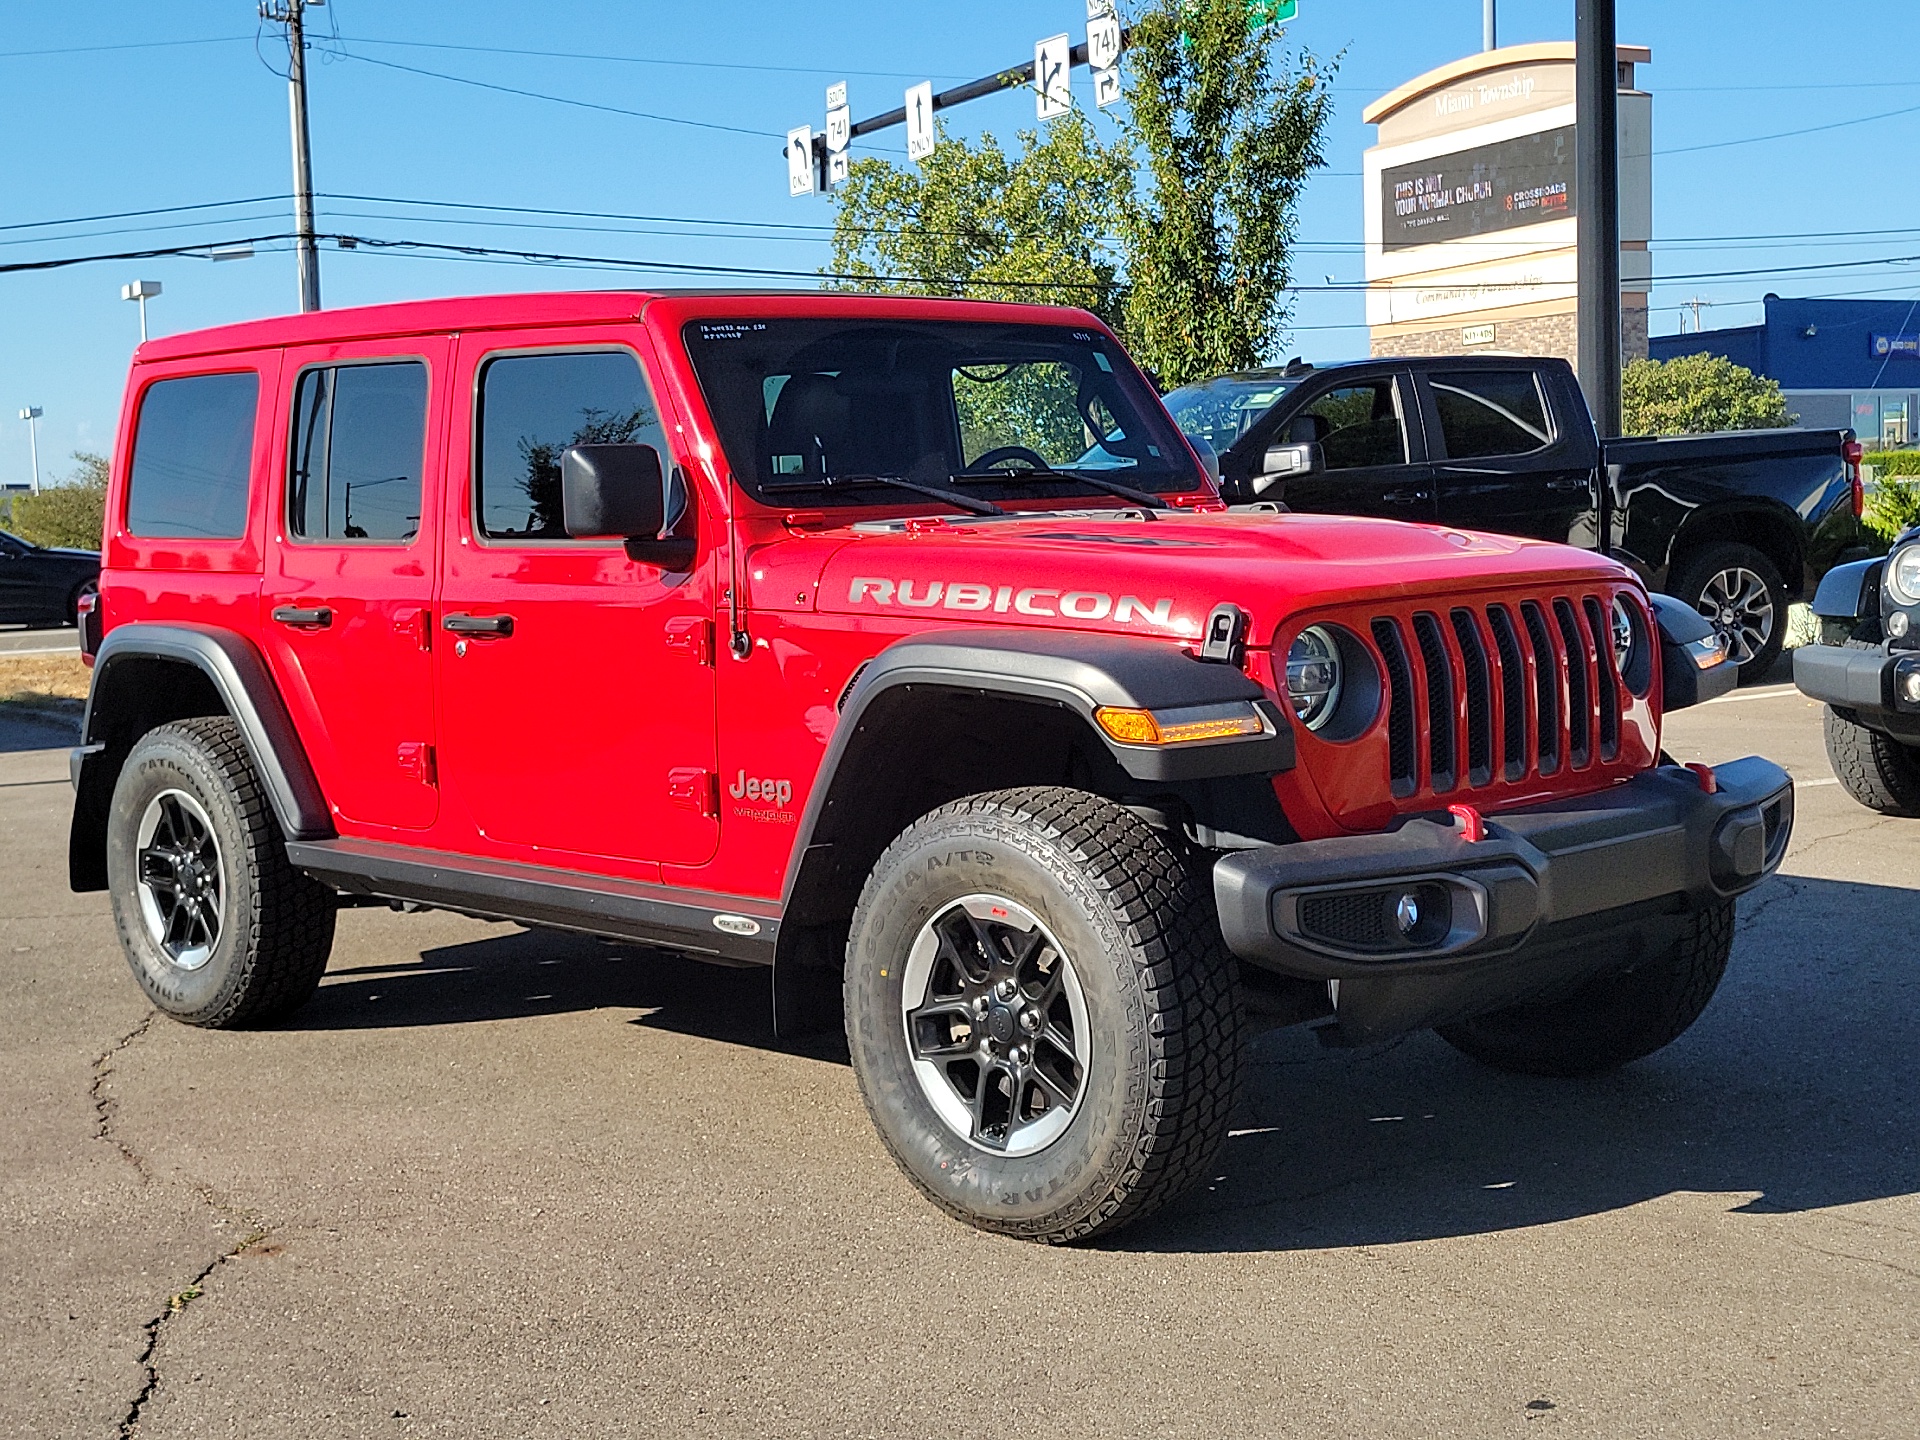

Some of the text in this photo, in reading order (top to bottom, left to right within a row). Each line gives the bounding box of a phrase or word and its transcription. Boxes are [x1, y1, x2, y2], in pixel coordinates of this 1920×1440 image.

[1092, 27, 1117, 57] 741
[1434, 72, 1535, 117] Miami Township
[830, 118, 848, 142] 741
[911, 134, 931, 154] ONLY
[792, 172, 810, 189] ONLY
[1395, 173, 1443, 199] THIS IS NOT
[1395, 181, 1493, 216] YOUR NORMAL CHURCH
[848, 576, 1176, 627] RUBICON
[729, 769, 793, 809] Jeep
[733, 806, 797, 823] WRANGLER
